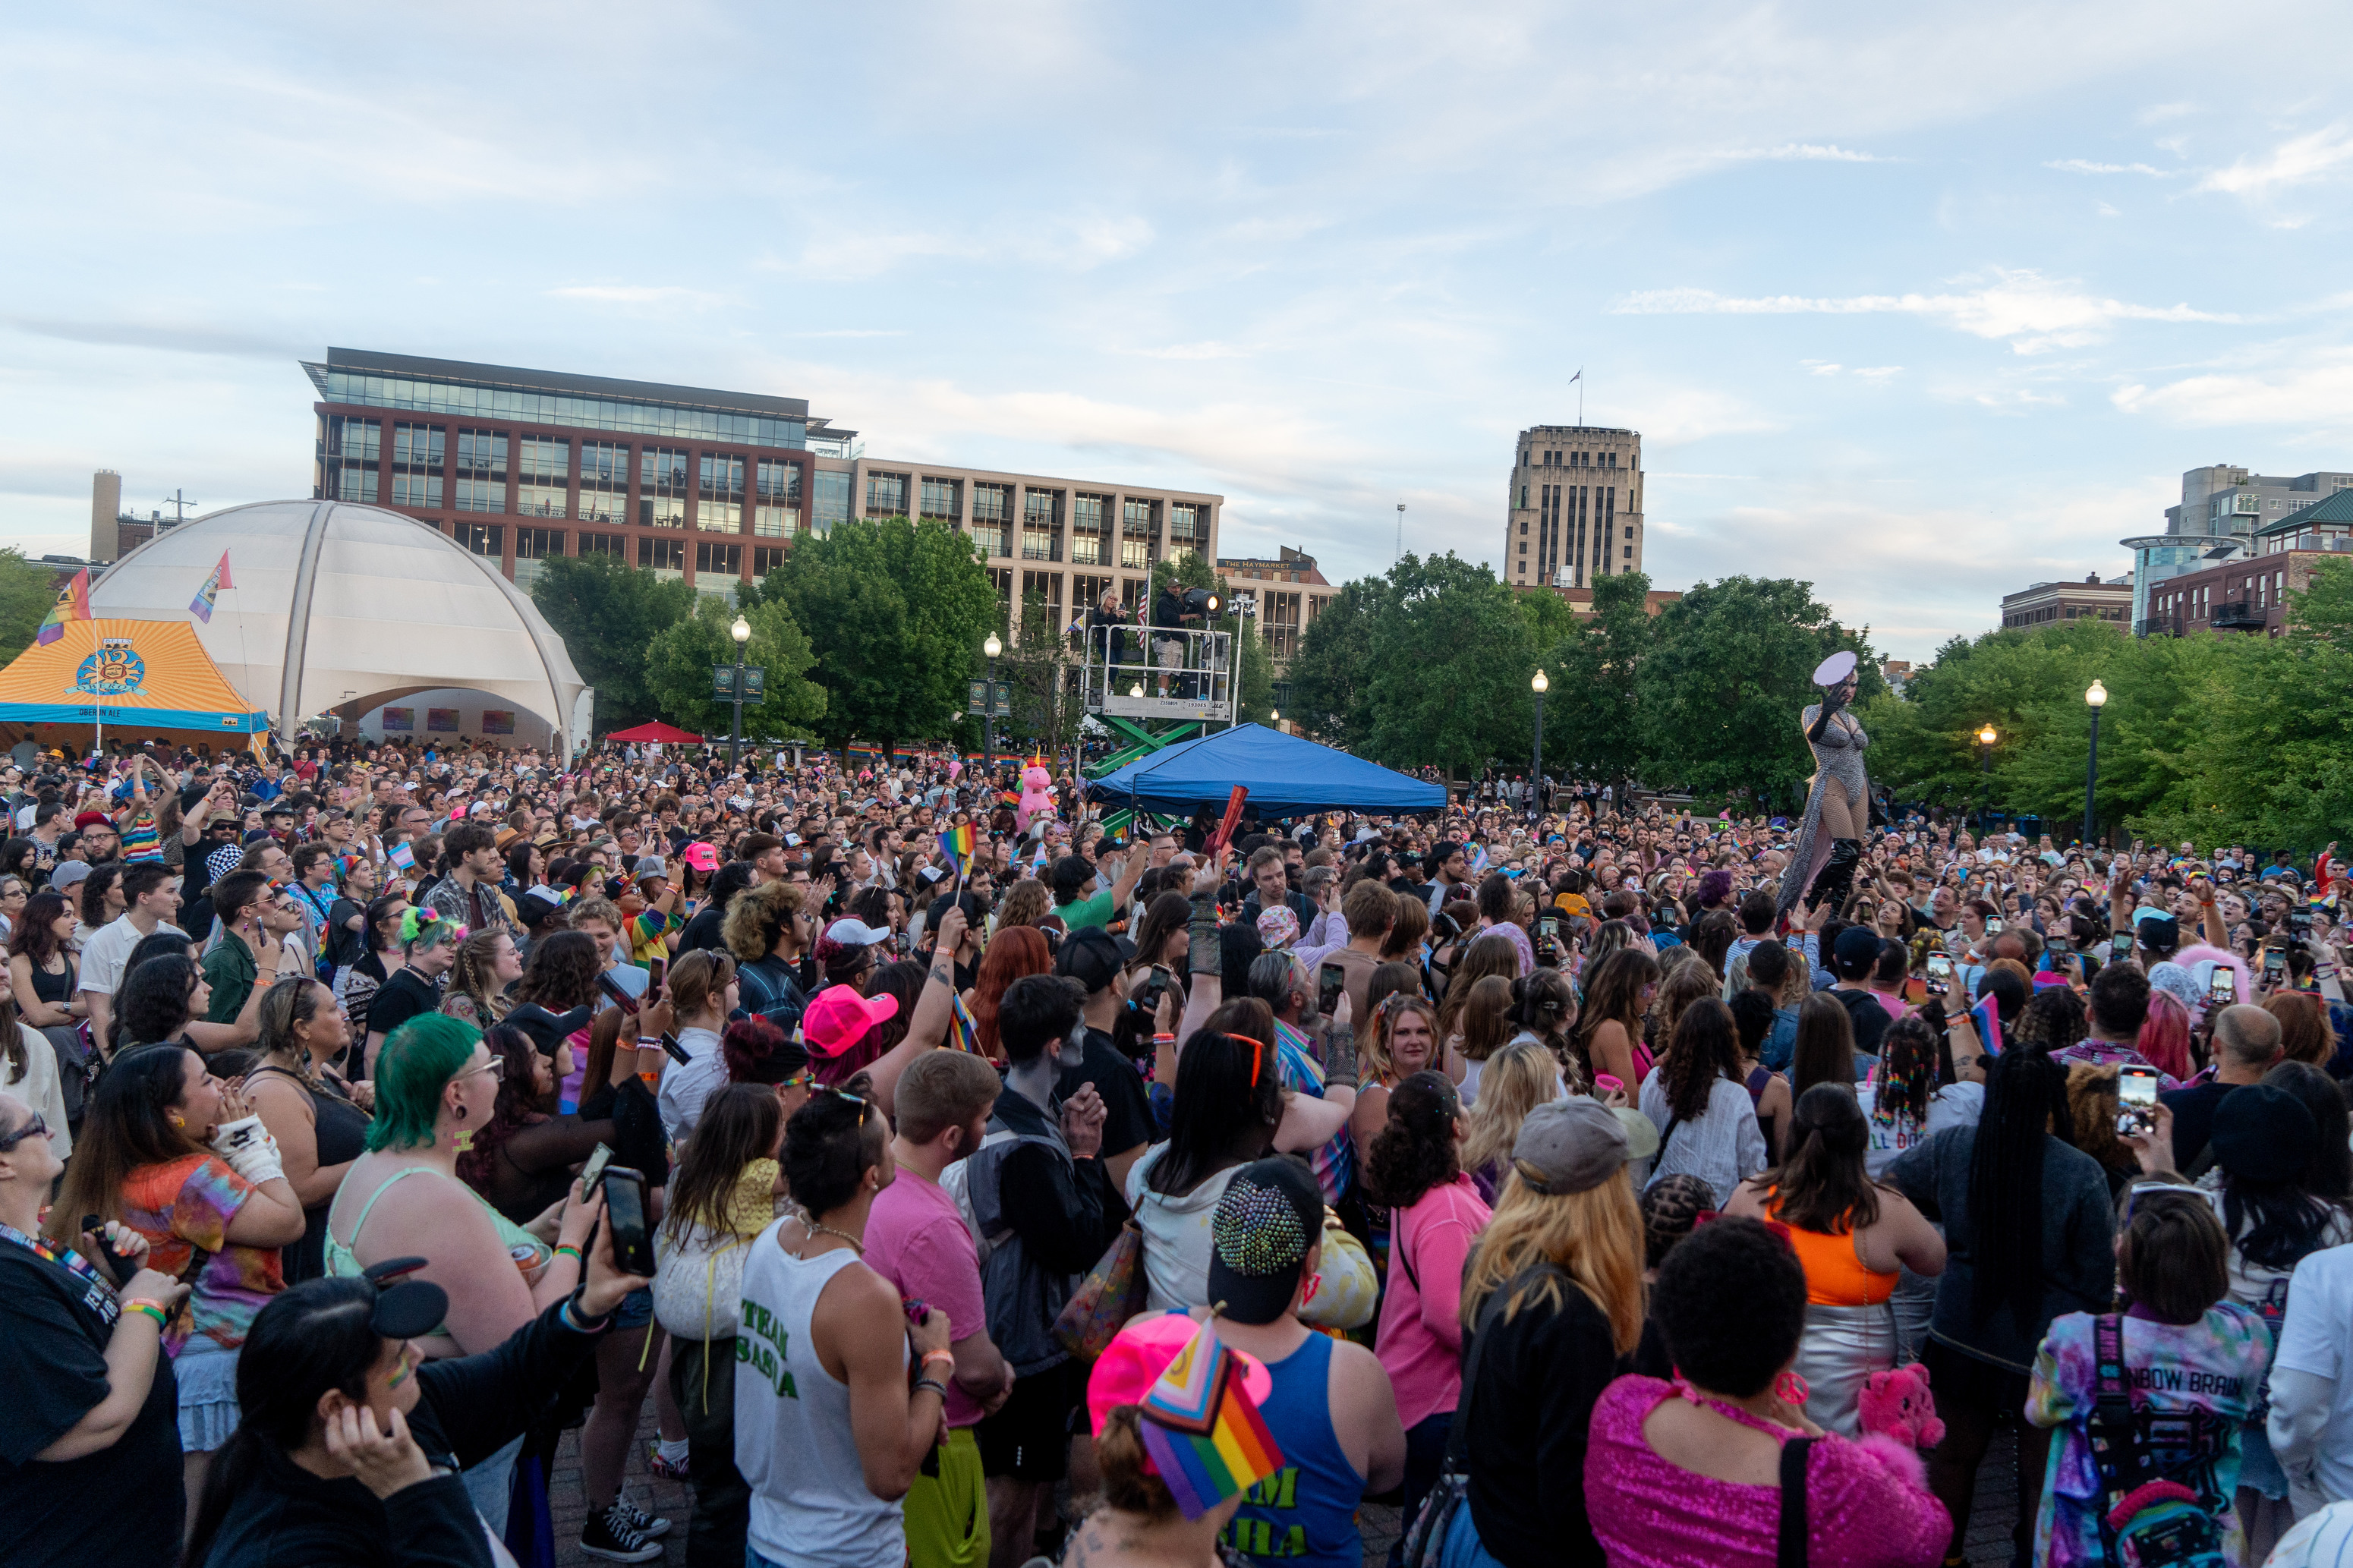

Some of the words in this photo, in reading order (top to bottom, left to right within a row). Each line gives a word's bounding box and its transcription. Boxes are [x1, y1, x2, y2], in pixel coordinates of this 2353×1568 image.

[76, 682, 139, 692] OBERON
[1866, 1133, 1890, 1151] LL
[741, 1298, 789, 1361] TEAM
[2189, 1372, 2243, 1397] BRAIN
